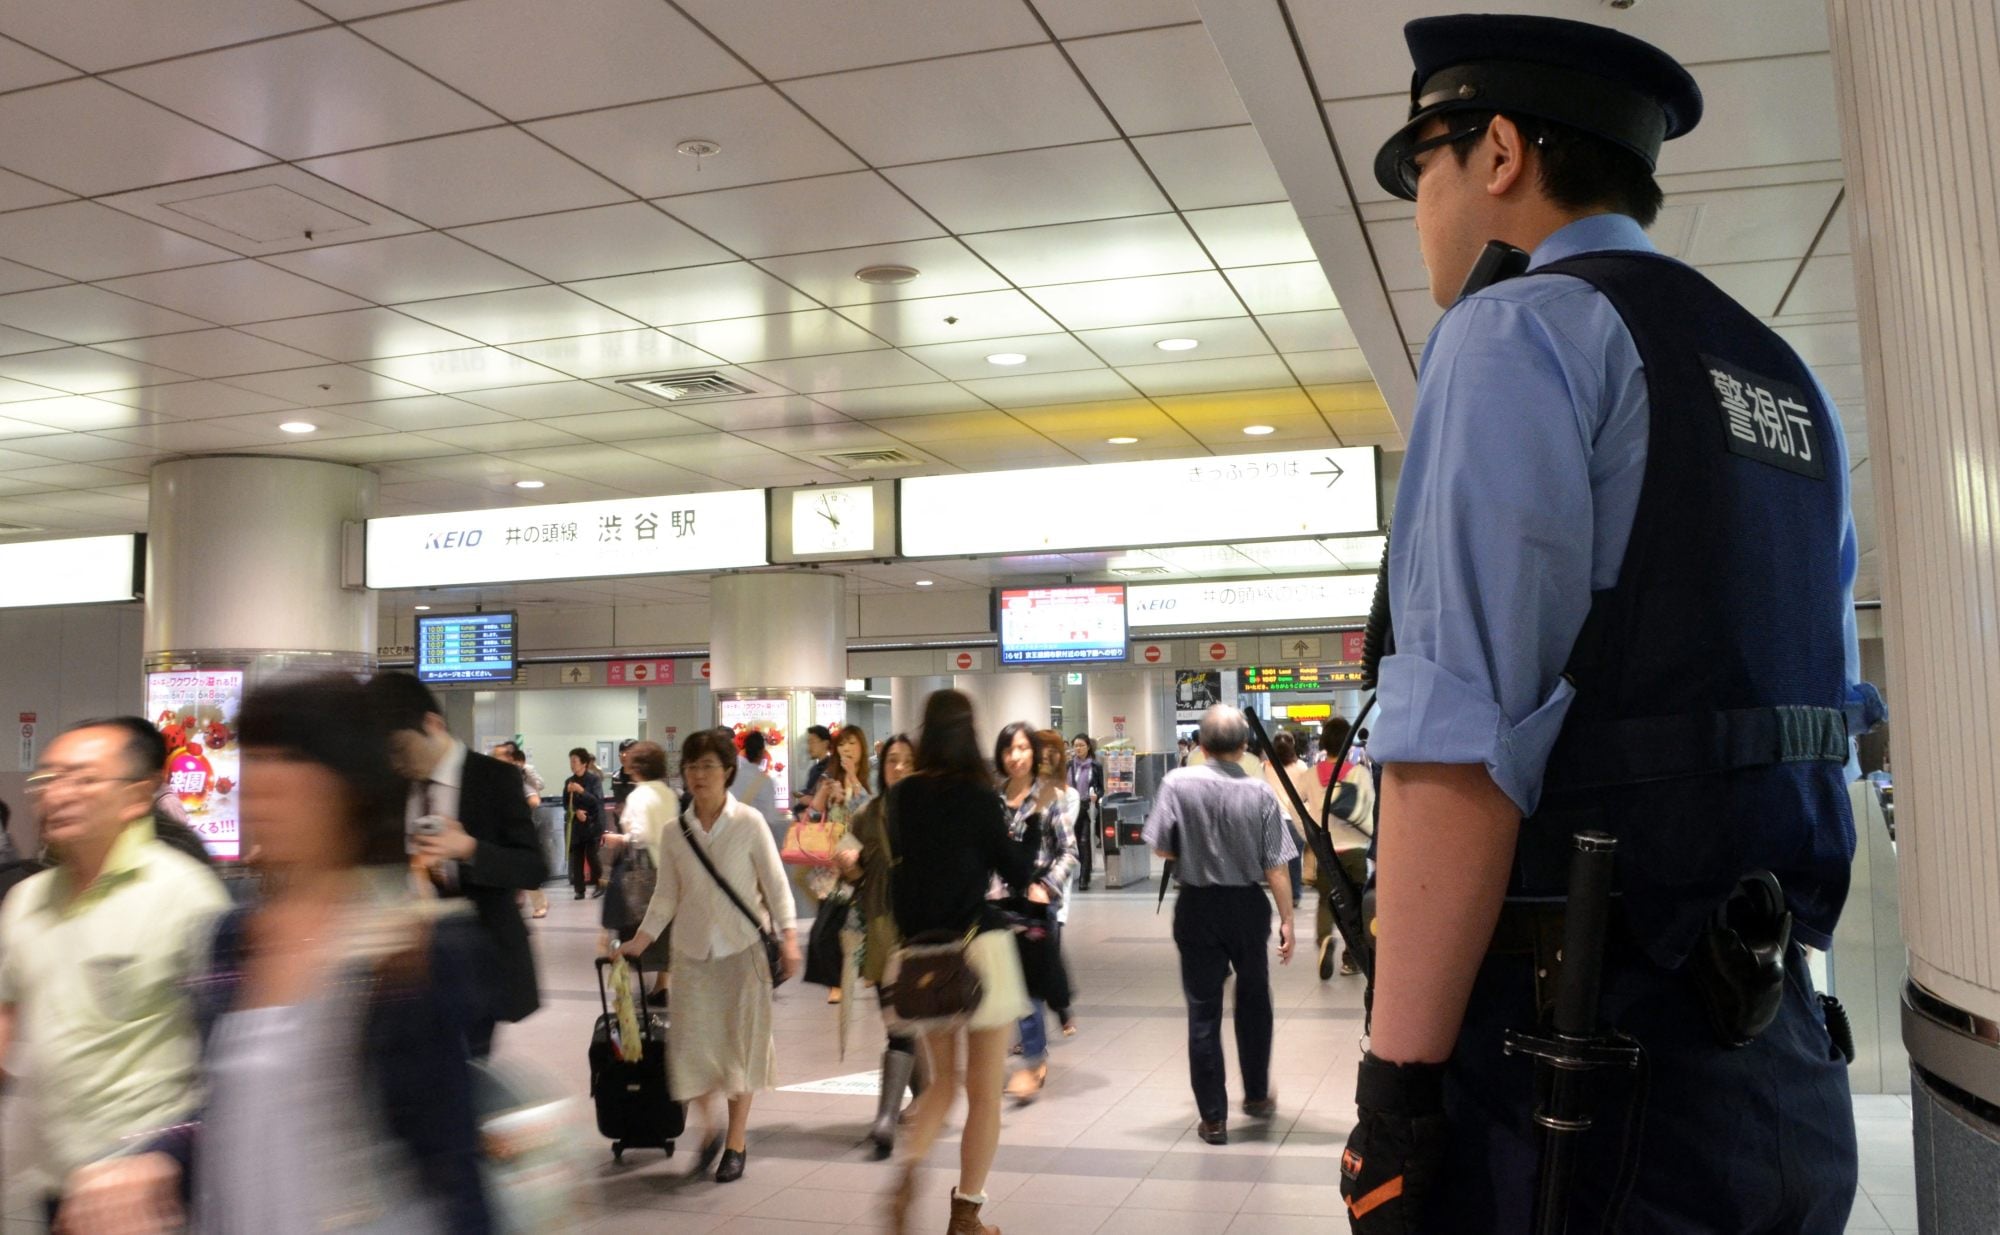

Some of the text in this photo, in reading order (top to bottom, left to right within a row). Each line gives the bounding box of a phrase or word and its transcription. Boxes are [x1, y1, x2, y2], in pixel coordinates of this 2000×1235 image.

[1709, 369, 1812, 461] 警視庁
[424, 509, 697, 550] KEIO 井の頭線 渋谷駅
[169, 770, 206, 793] 楽園
